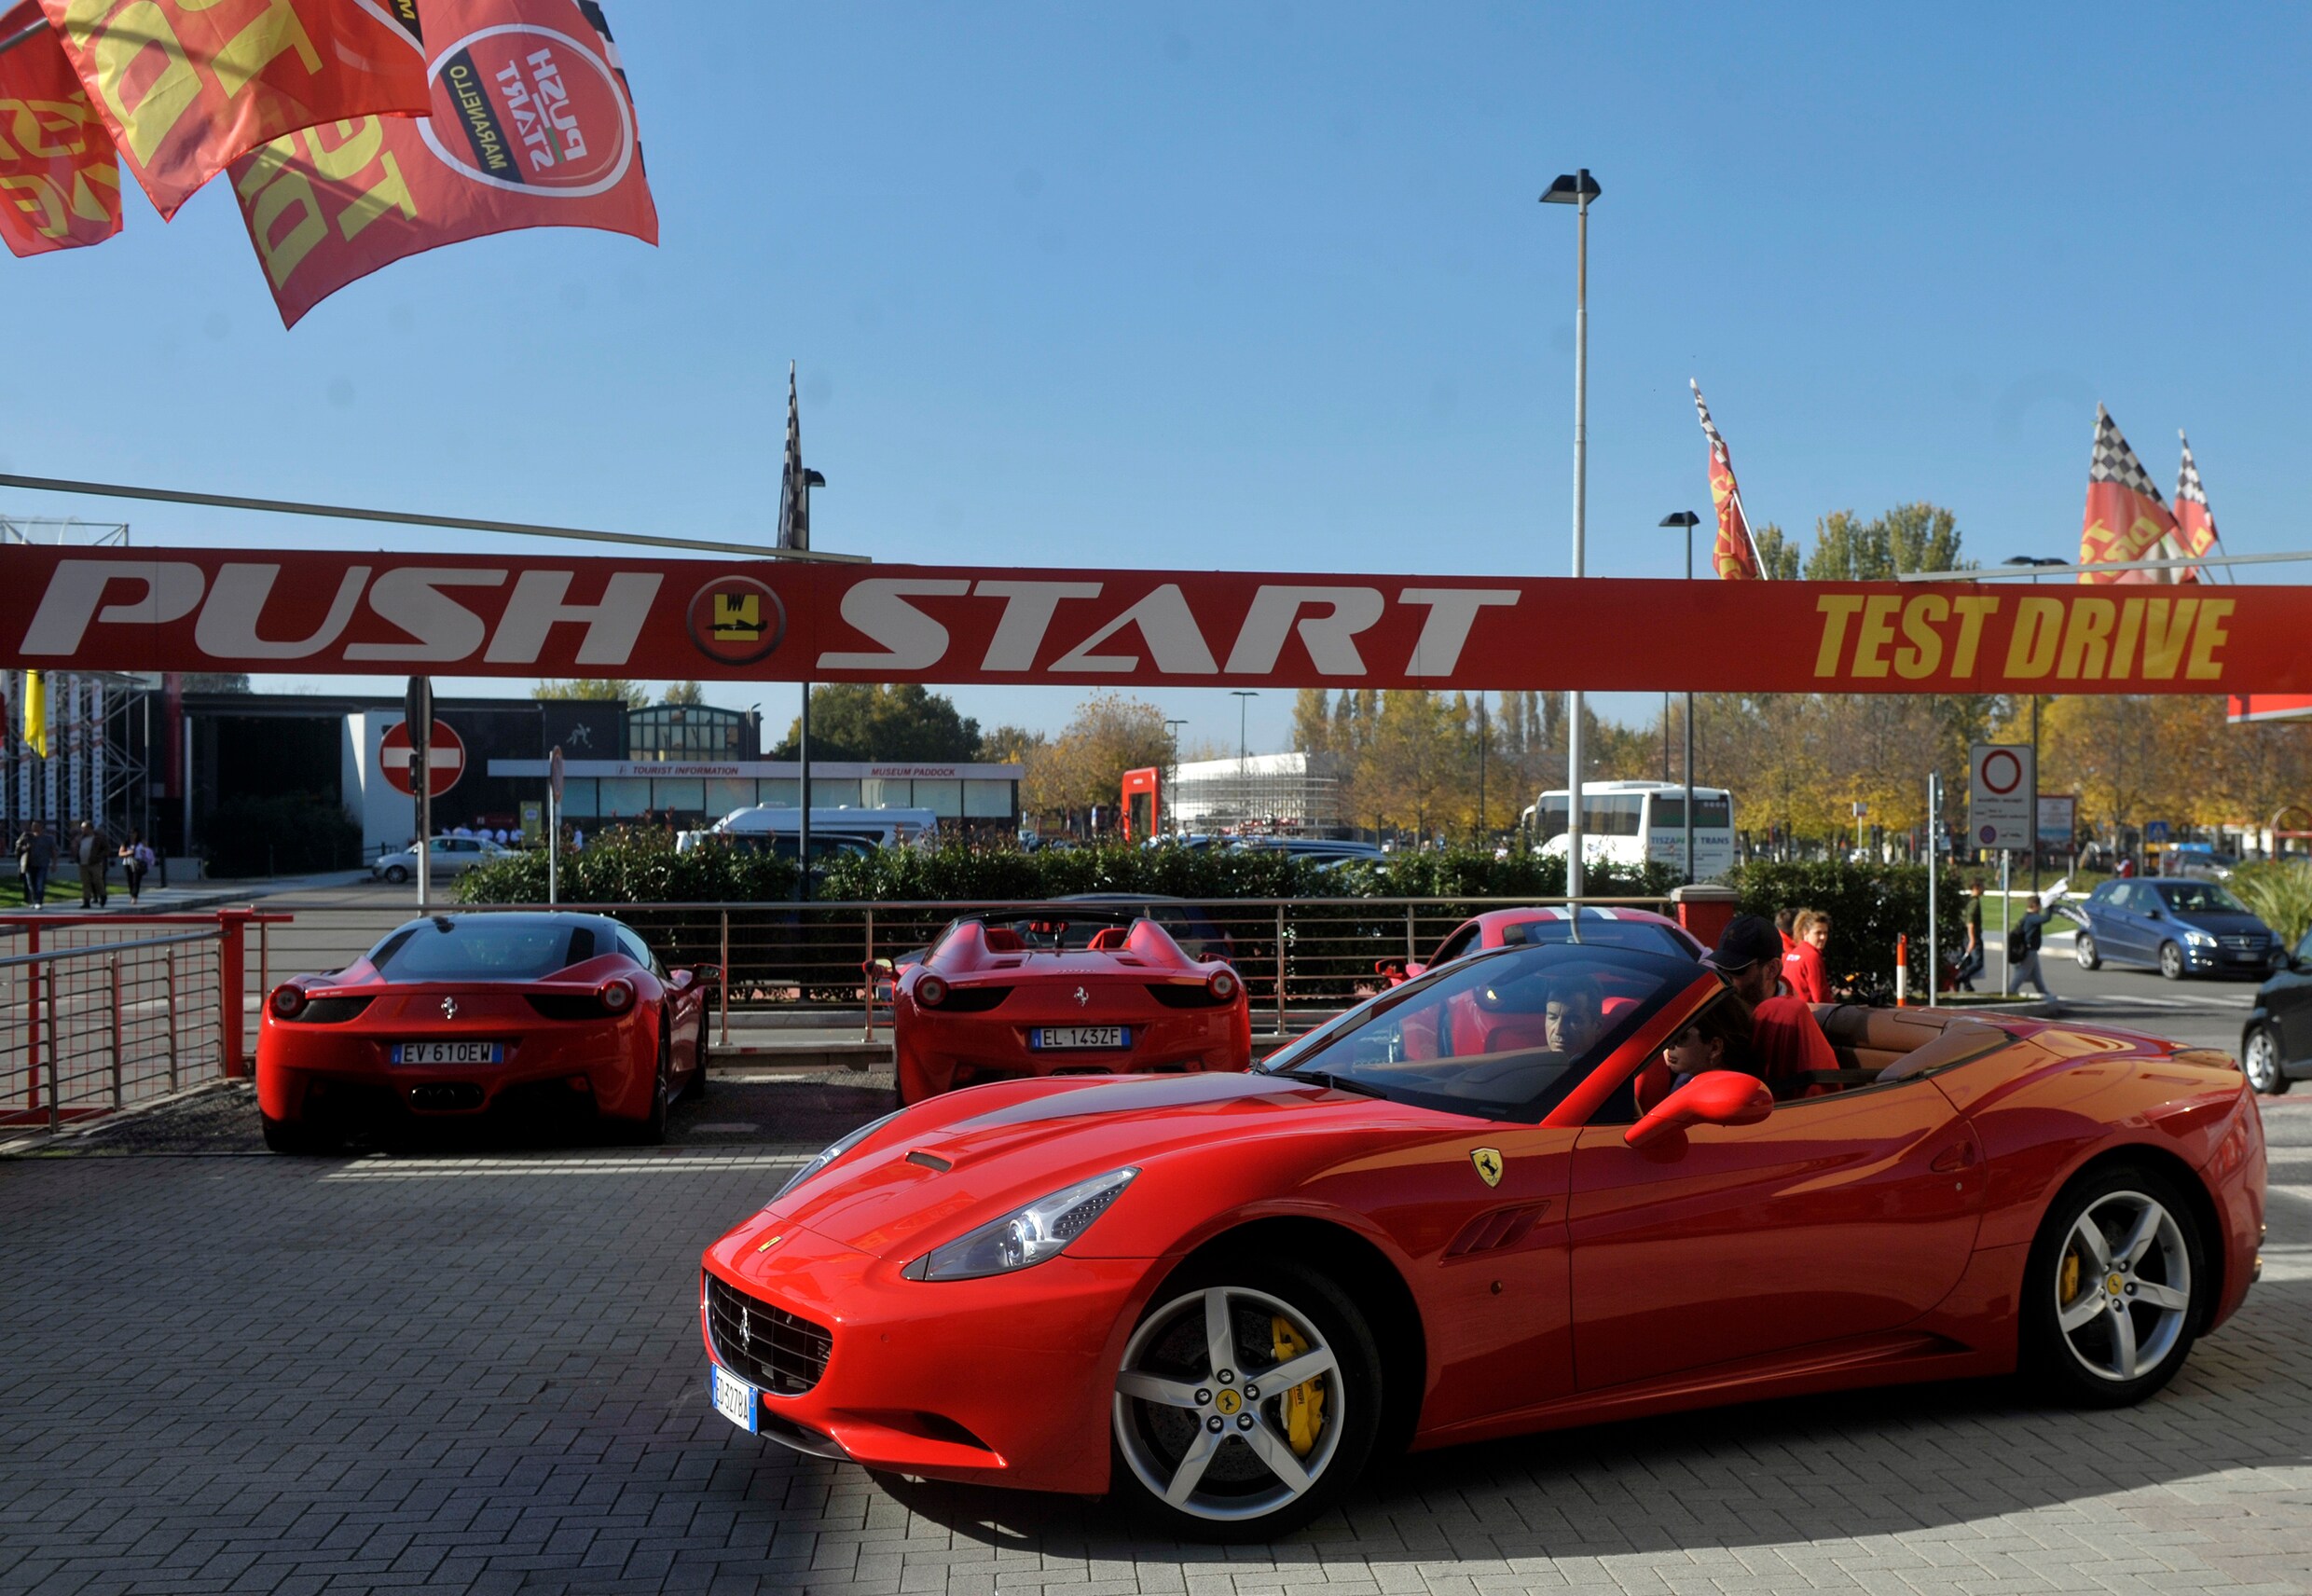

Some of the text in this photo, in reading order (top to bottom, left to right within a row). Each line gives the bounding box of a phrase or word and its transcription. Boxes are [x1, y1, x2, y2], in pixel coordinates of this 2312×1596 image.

[19, 559, 1521, 678] PUSH START
[1813, 594, 2236, 681] TEST DRIVE
[633, 765, 672, 775] TOURIST
[675, 766, 738, 776] INFORMATION
[871, 768, 956, 777] MUSEUM PADDOCK
[1044, 1028, 1119, 1046] EL 143ZF
[404, 1044, 425, 1062] EV
